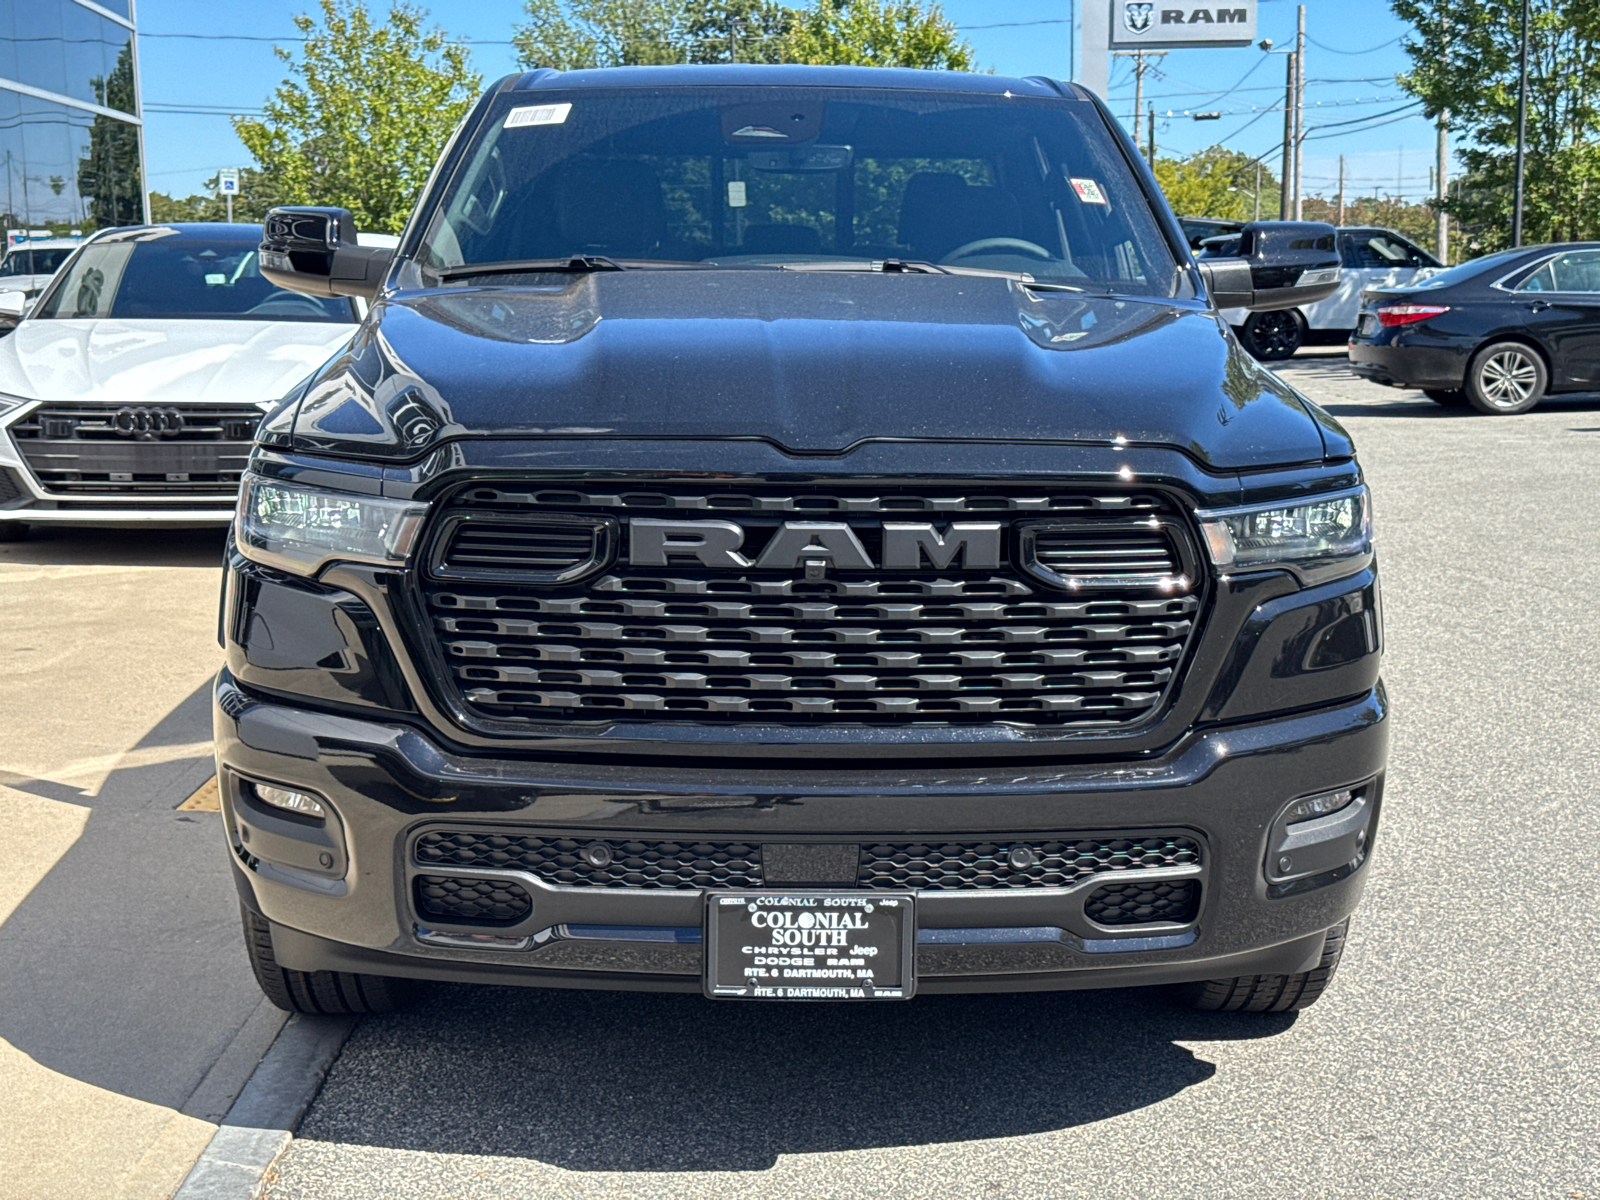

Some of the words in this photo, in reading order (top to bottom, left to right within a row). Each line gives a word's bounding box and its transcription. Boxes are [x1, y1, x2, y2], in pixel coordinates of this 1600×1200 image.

[1161, 9, 1247, 24] RAM
[629, 517, 1001, 570] RAM
[823, 898, 867, 907] SOUTH
[772, 929, 848, 946] SOUTH
[741, 946, 838, 955] CHRYSLER
[849, 945, 878, 956] Jeep
[754, 957, 815, 966] DODGE
[826, 958, 865, 966] RAM
[744, 968, 770, 977] RTE.
[771, 968, 779, 977] 6
[783, 968, 855, 979] DARTMOUTH,
[856, 969, 874, 978] MA
[754, 988, 776, 997] RTE.
[777, 988, 784, 997] 6
[787, 988, 849, 999] DARTMOUTH,
[850, 988, 865, 998] MA
